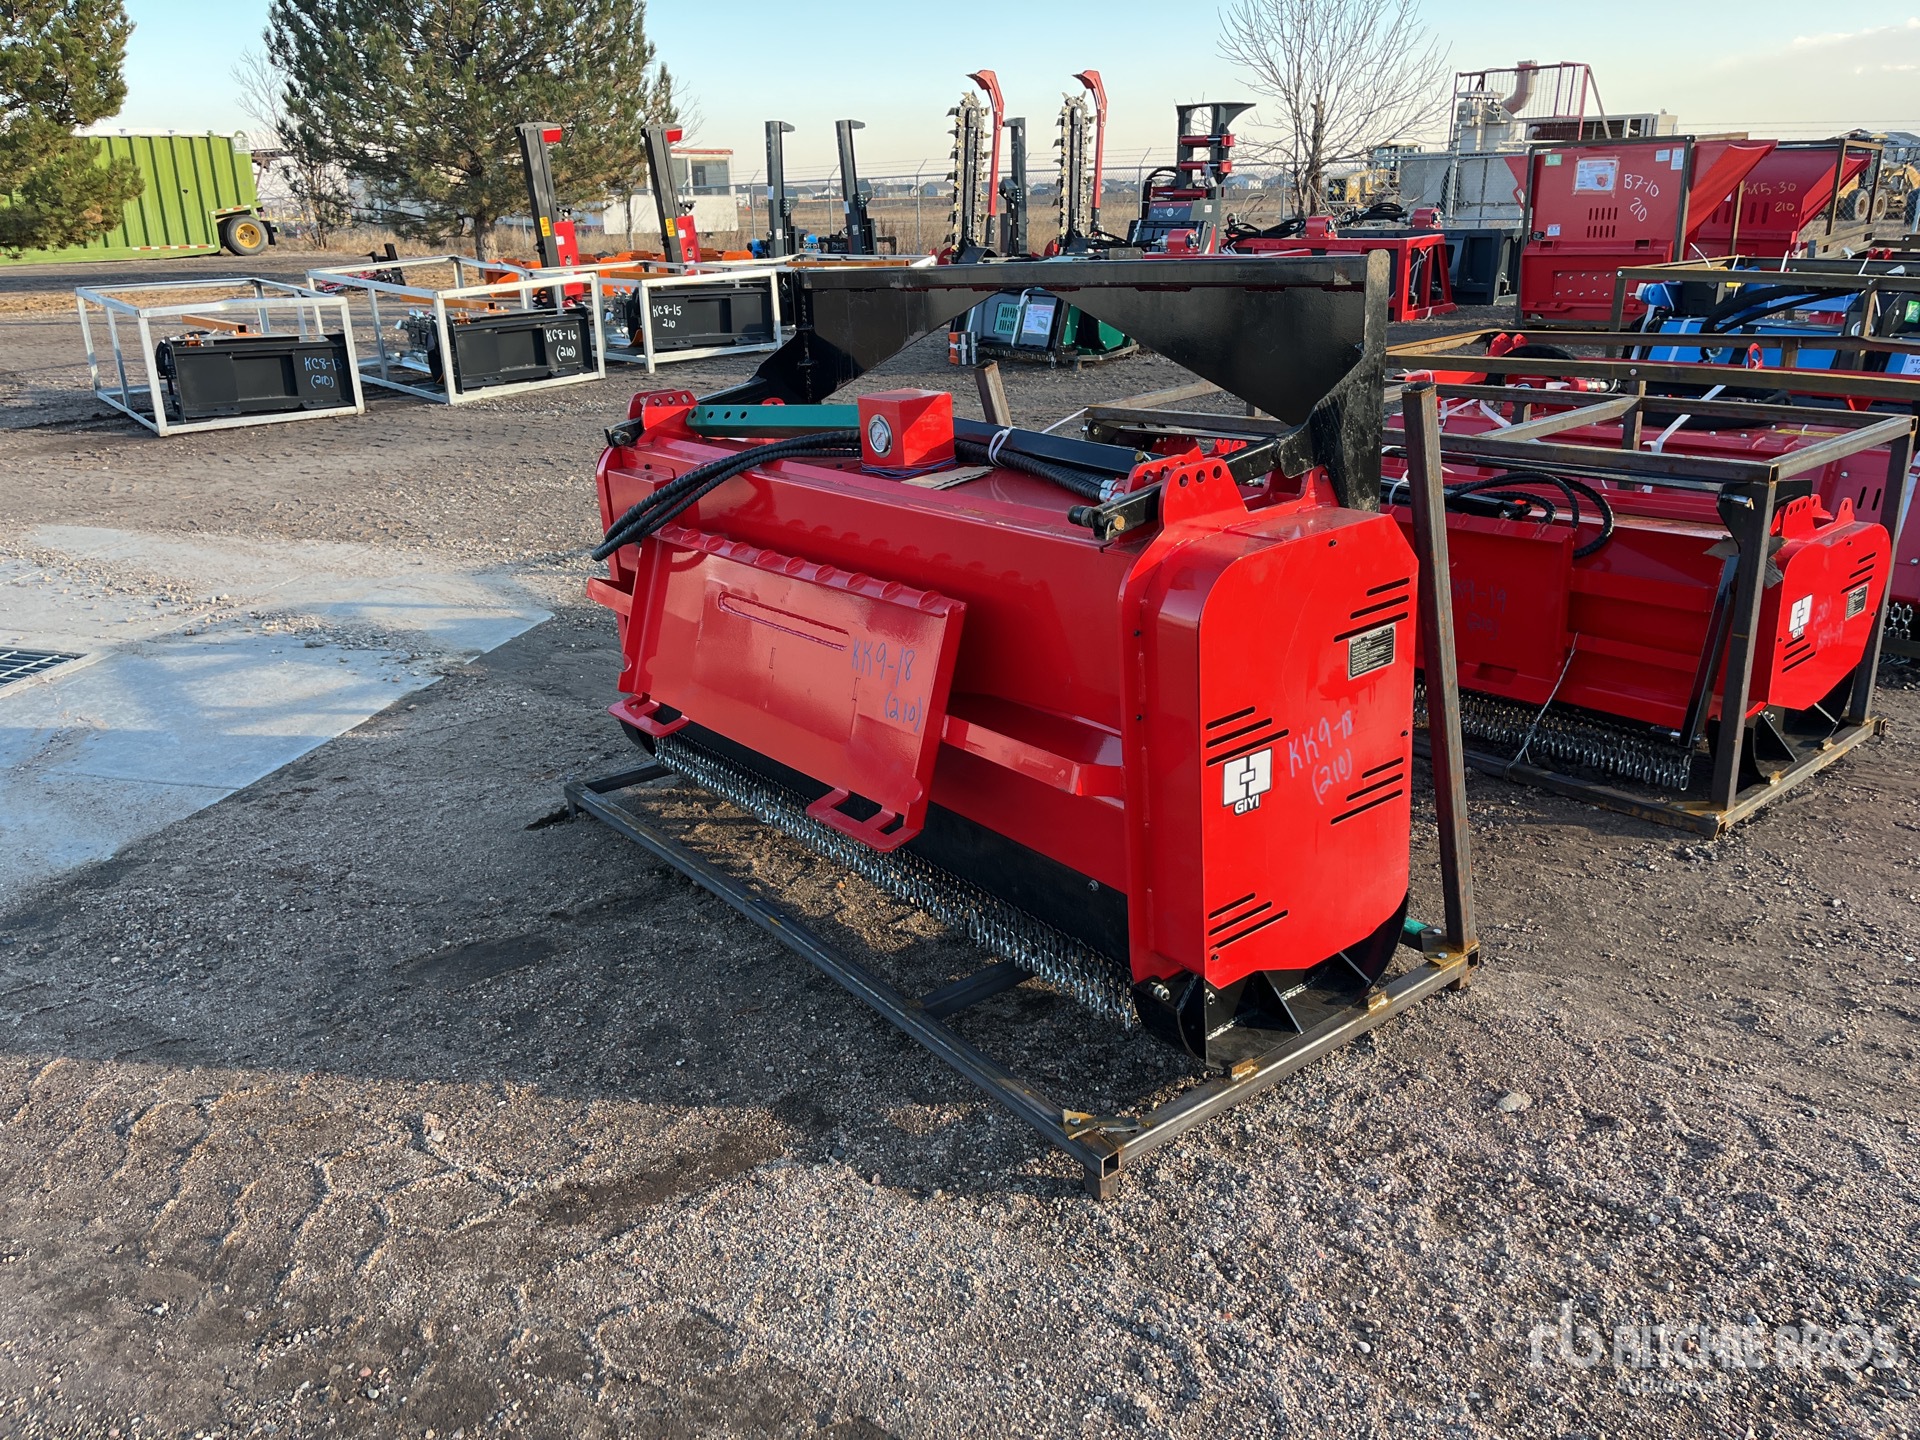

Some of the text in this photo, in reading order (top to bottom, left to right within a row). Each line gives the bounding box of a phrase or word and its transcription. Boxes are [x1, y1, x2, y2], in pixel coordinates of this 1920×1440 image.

[1623, 173, 1660, 198] B7-10
[1629, 197, 1648, 222] 210
[1774, 201, 1795, 213] 210
[652, 303, 682, 318] KC8-15
[662, 318, 676, 329] 210
[545, 329, 577, 343] KC8-16
[556, 344, 576, 362] (210)
[310, 374, 335, 389] (210)
[851, 636, 916, 688] KK9-18
[884, 690, 923, 733] (210)
[1288, 709, 1354, 778] KK9-18
[1311, 748, 1353, 805] (210)
[1234, 794, 1260, 815] GIYI
